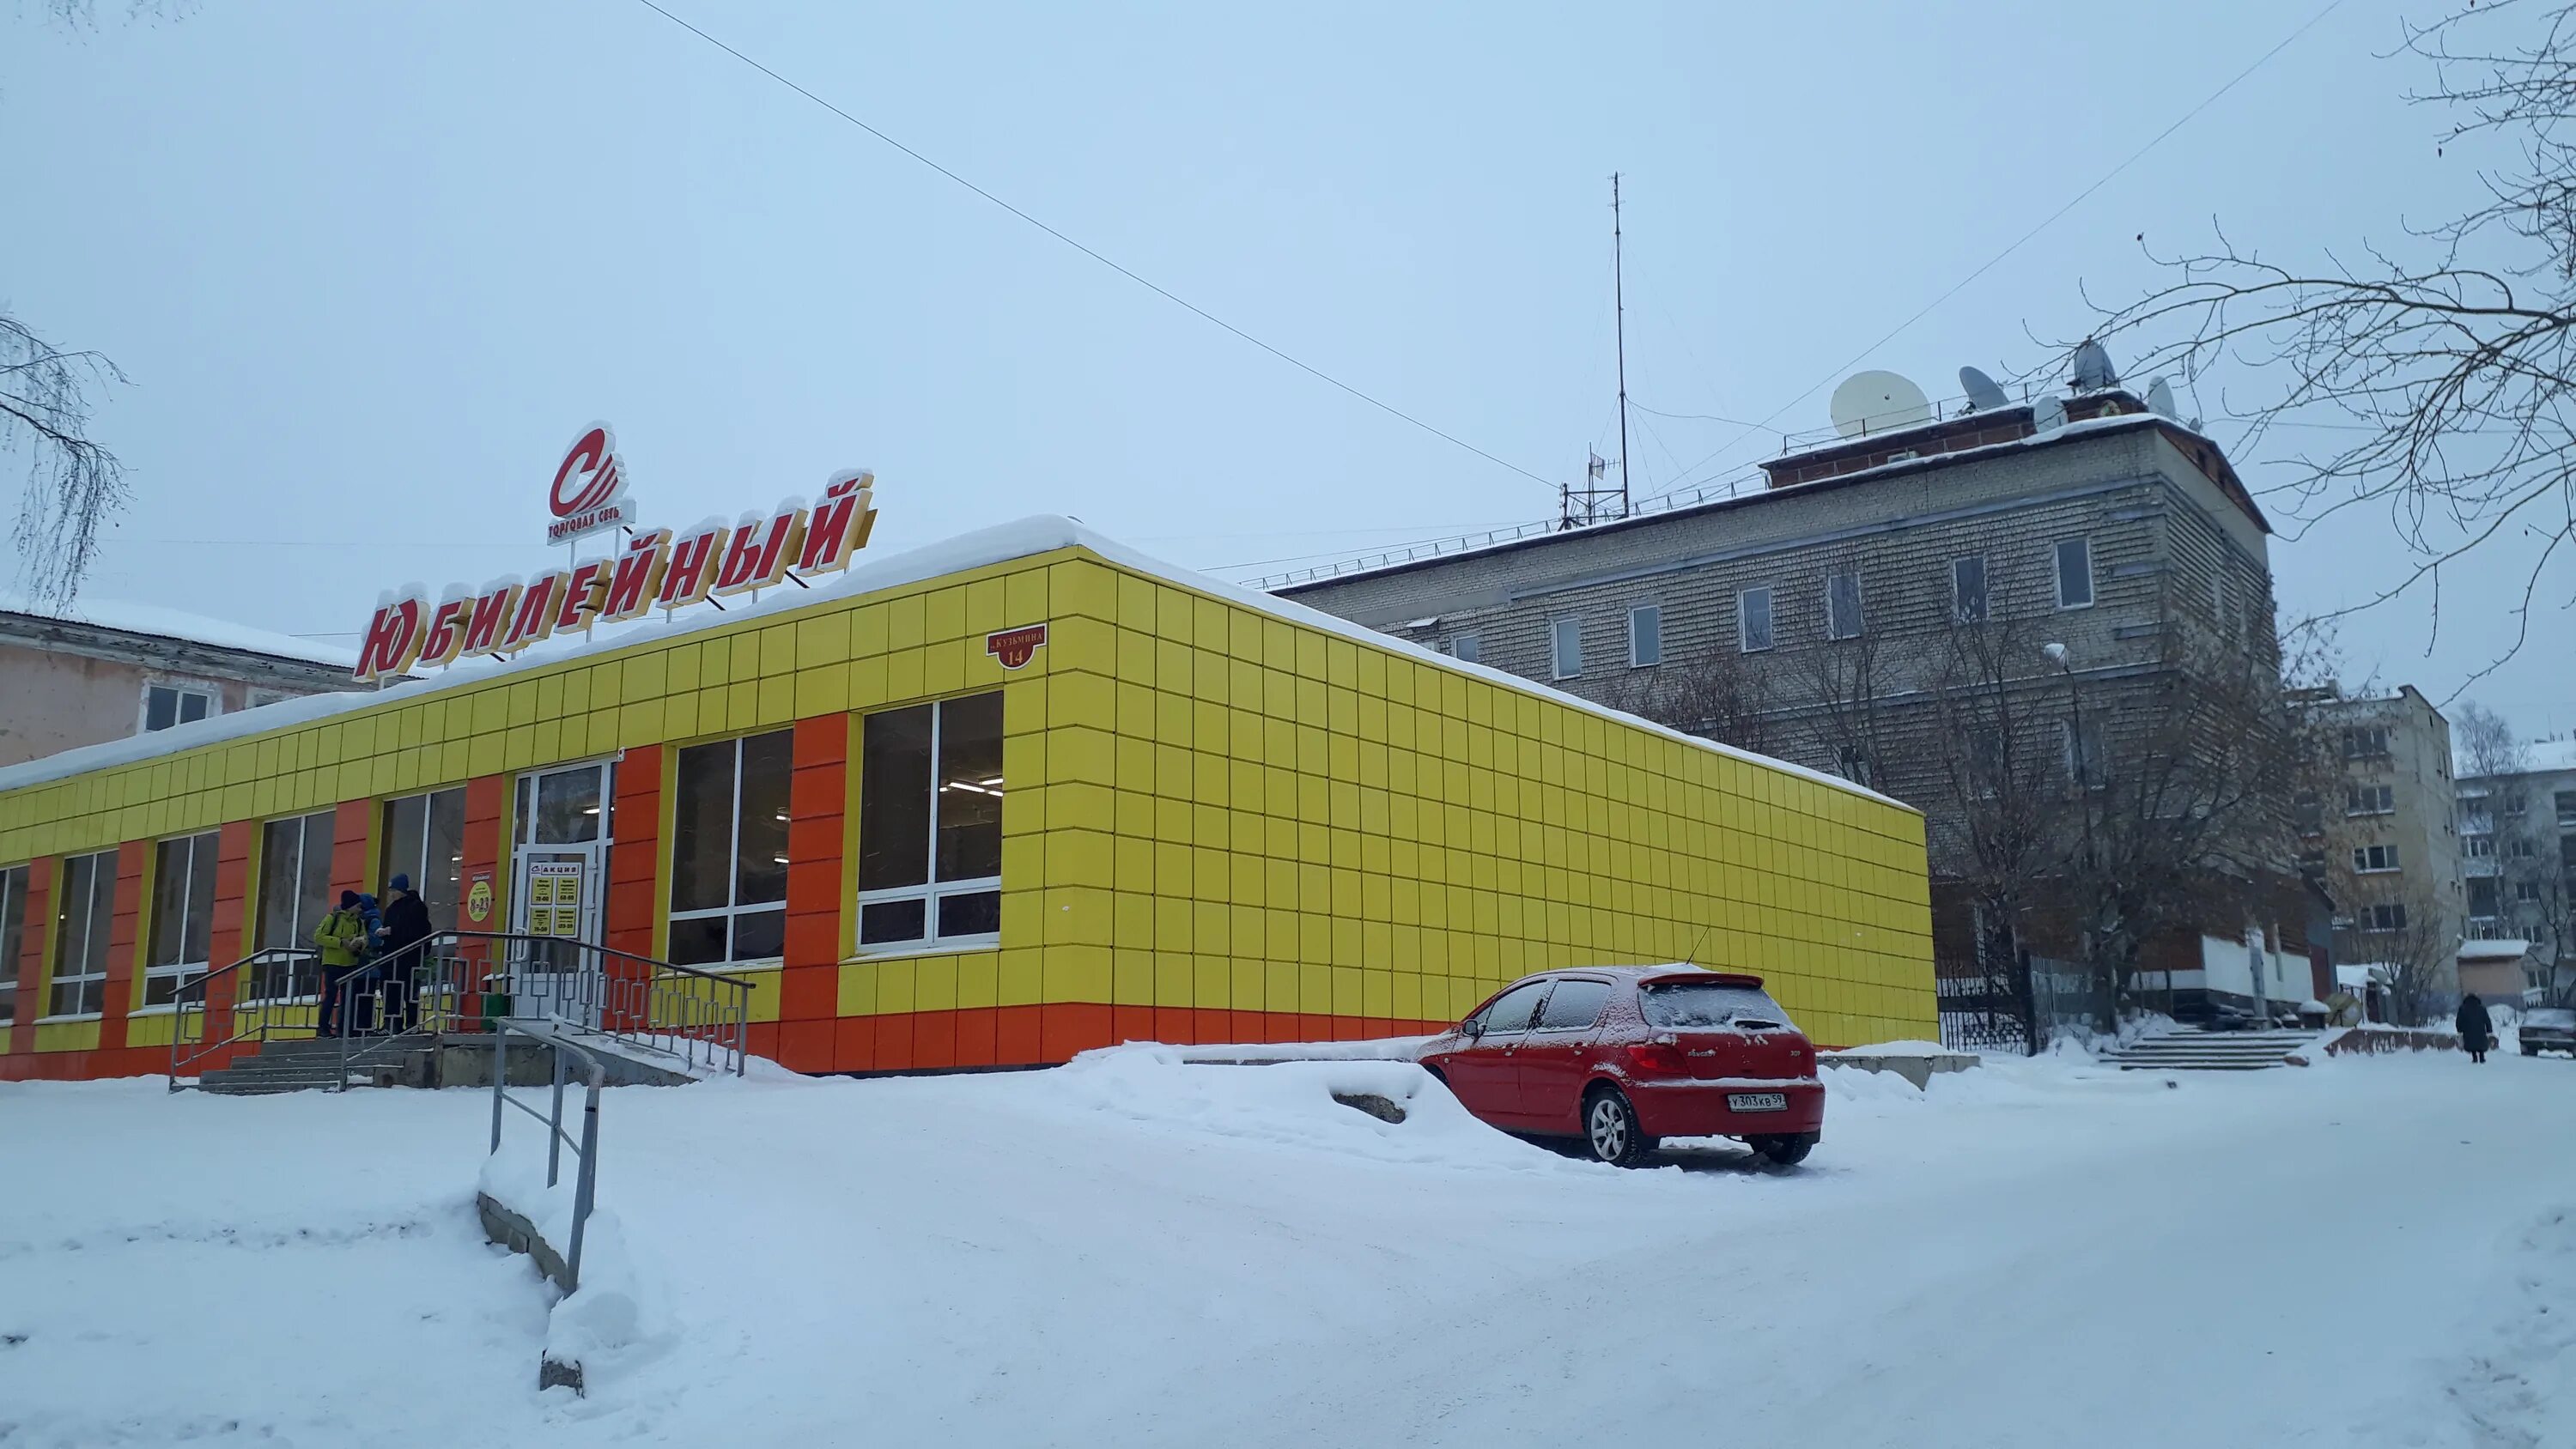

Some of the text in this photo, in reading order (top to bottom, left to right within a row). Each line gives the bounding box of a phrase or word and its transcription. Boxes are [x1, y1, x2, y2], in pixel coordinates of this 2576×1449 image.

[548, 506, 620, 538] ТОРГОВАЯ СЕТЬ
[352, 477, 866, 681] ЮБИЛЕЙНЫЙ
[996, 633, 1042, 648] КУЗЬМИНА
[1008, 649, 1023, 665] 14
